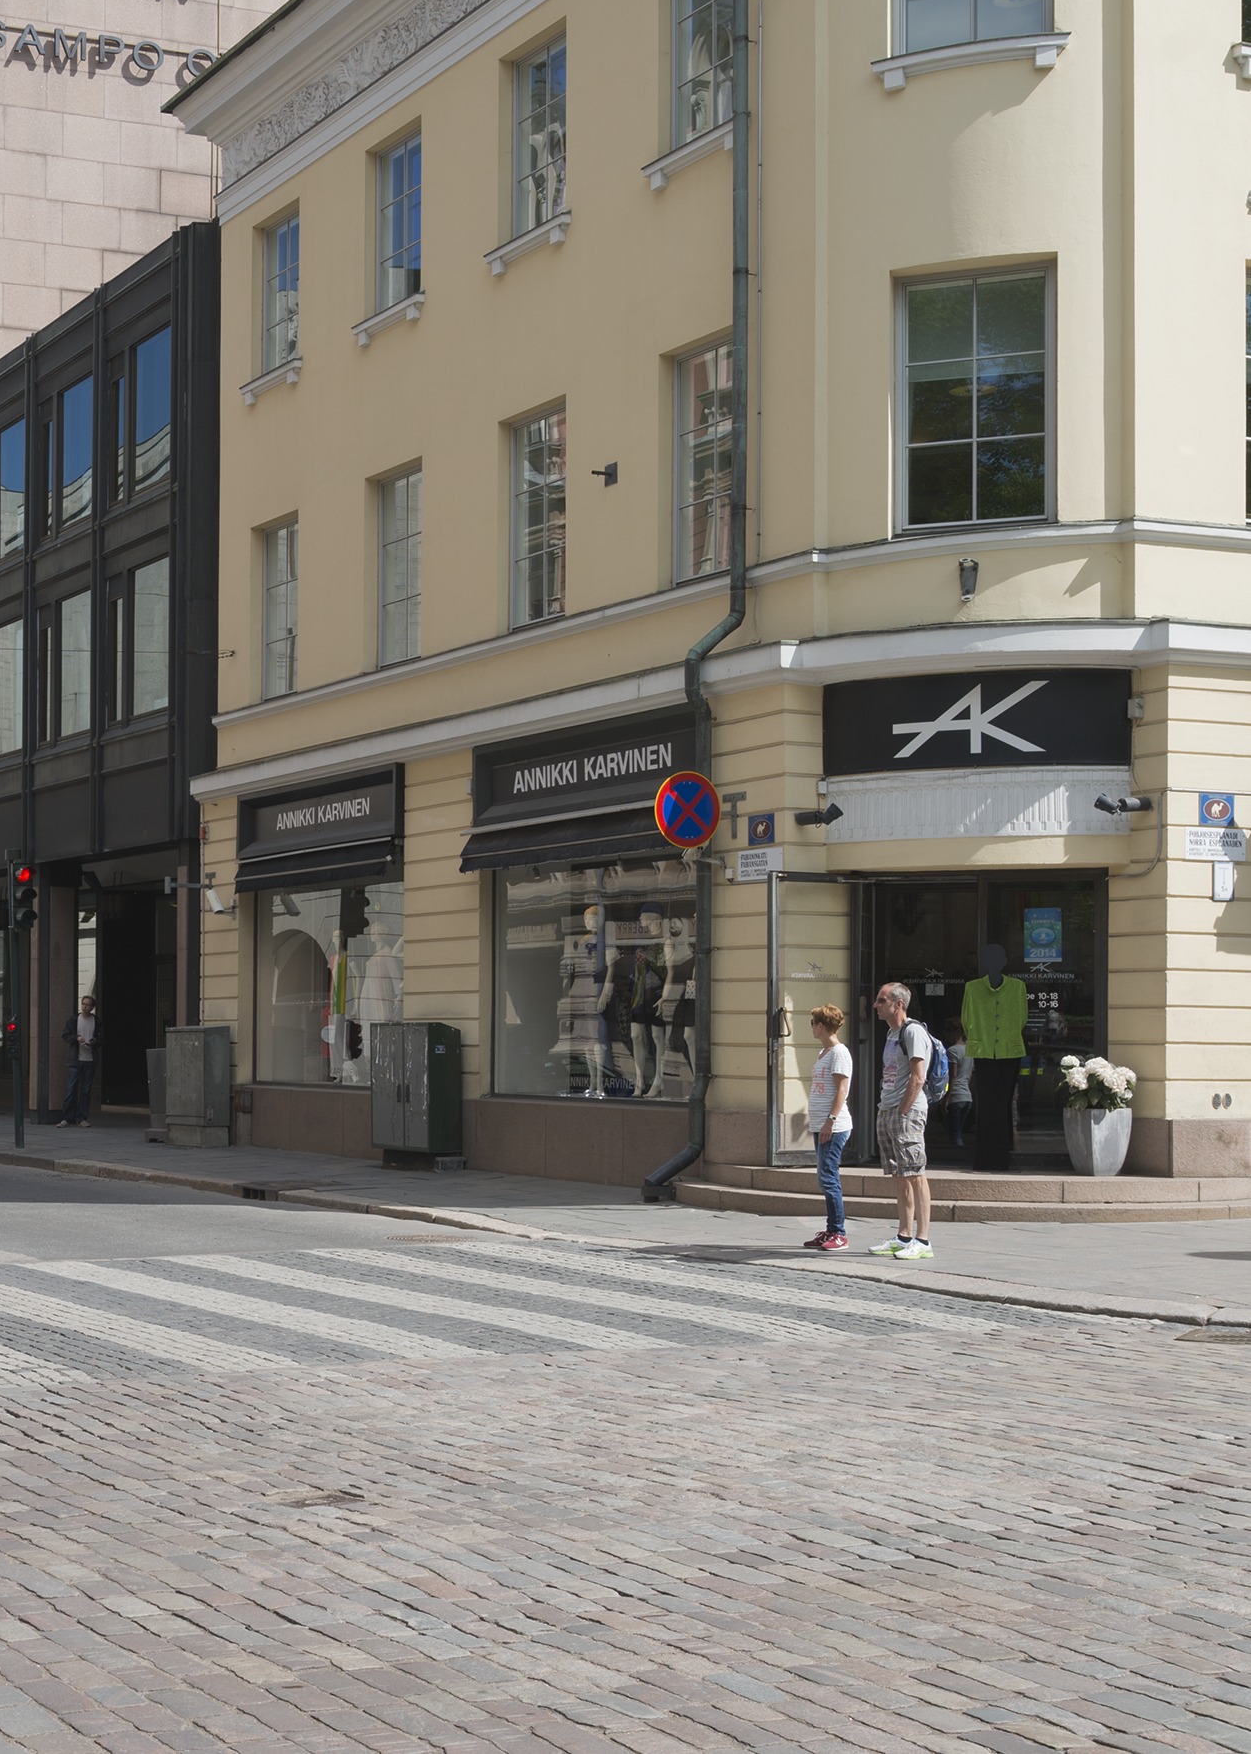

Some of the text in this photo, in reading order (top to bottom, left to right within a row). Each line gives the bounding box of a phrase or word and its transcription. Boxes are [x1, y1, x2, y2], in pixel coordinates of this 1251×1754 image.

[513, 742, 672, 795] ANNIKKI KARVINEN
[276, 796, 371, 831] ANNIKKI KARVINEN
[1030, 948, 1057, 958] 2014
[1037, 992, 1059, 1000] 10-18
[1037, 1000, 1059, 1008] 10-16
